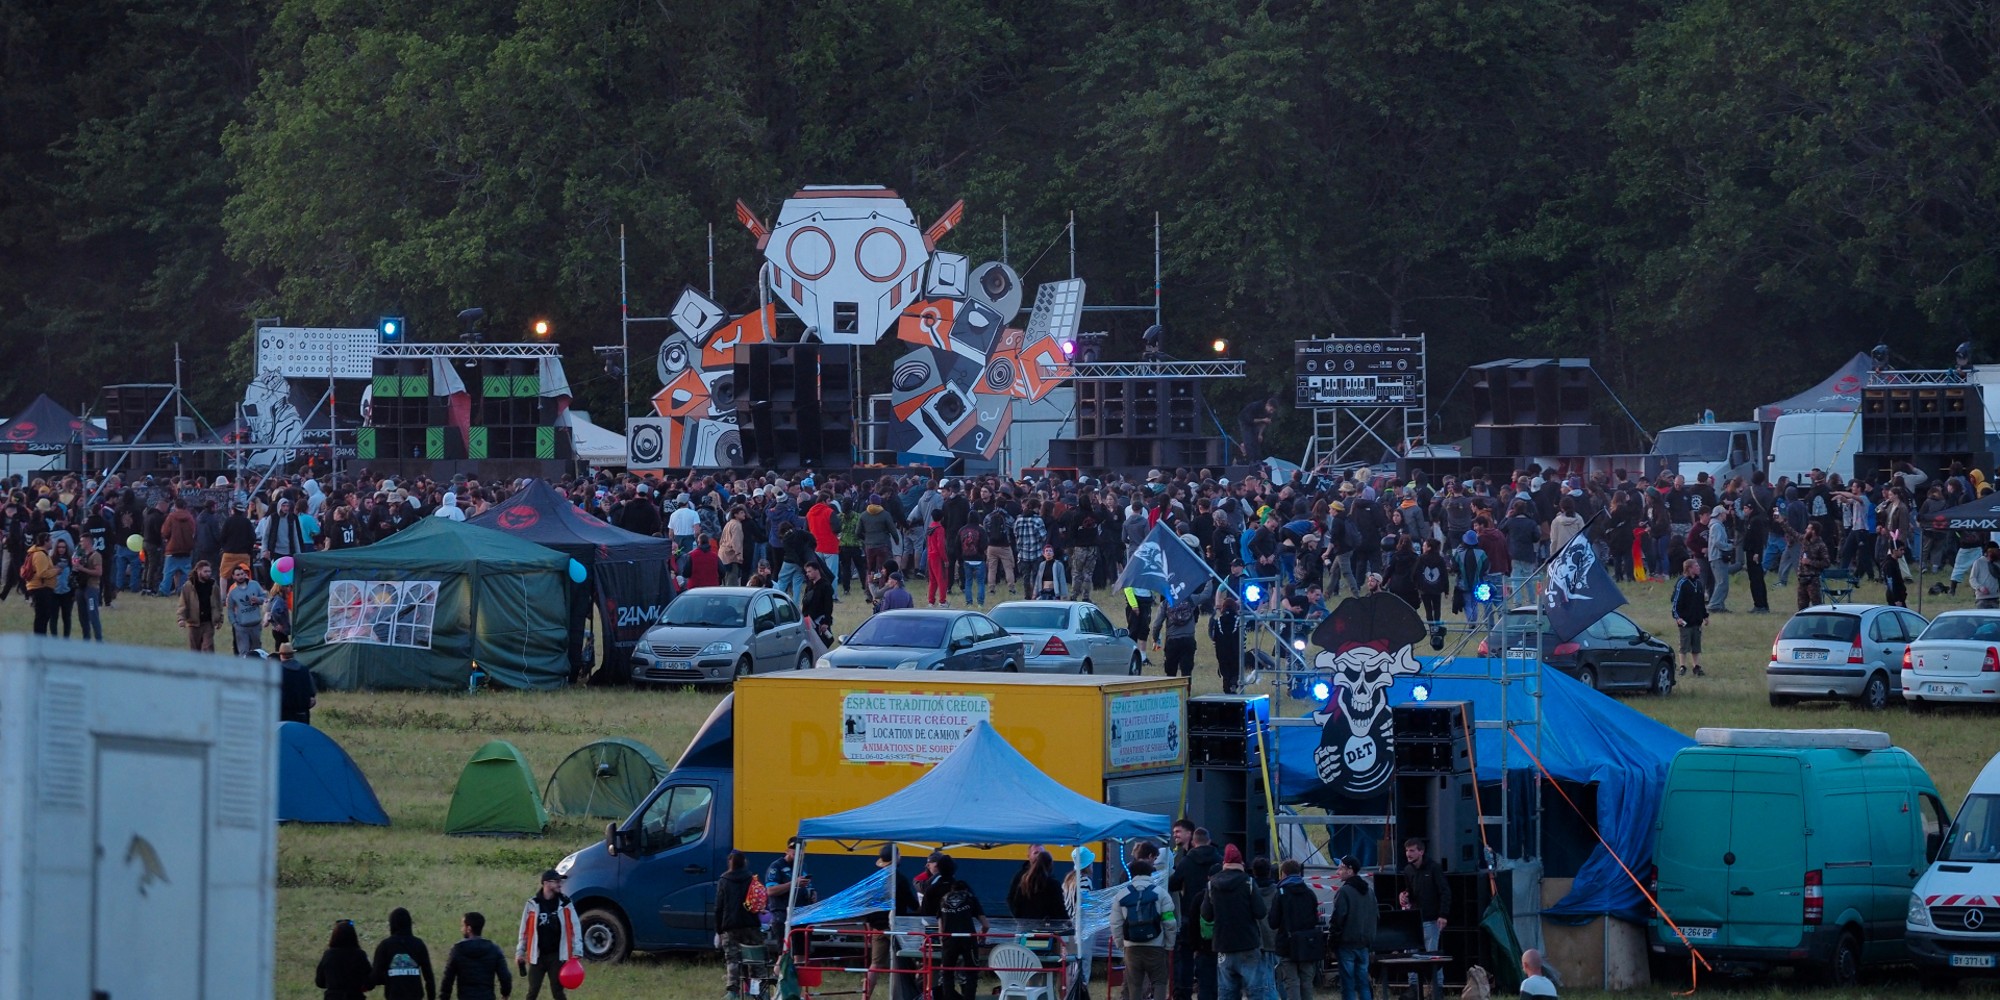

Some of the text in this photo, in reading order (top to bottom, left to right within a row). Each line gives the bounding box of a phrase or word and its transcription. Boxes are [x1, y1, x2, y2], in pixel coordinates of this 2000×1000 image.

[335, 448, 356, 456] 24MX
[1949, 519, 1998, 529] 24MX
[846, 697, 988, 713] ESPACE TRADITION CRÉOLE
[1111, 700, 1132, 714] ESPACE
[866, 713, 968, 726] TRAITEUR CRÉOLE
[872, 727, 960, 741] LOCATION DE CAMION
[861, 743, 914, 753] ANIMATIONS
[916, 744, 927, 753] DE
[1346, 741, 1374, 764] DET
